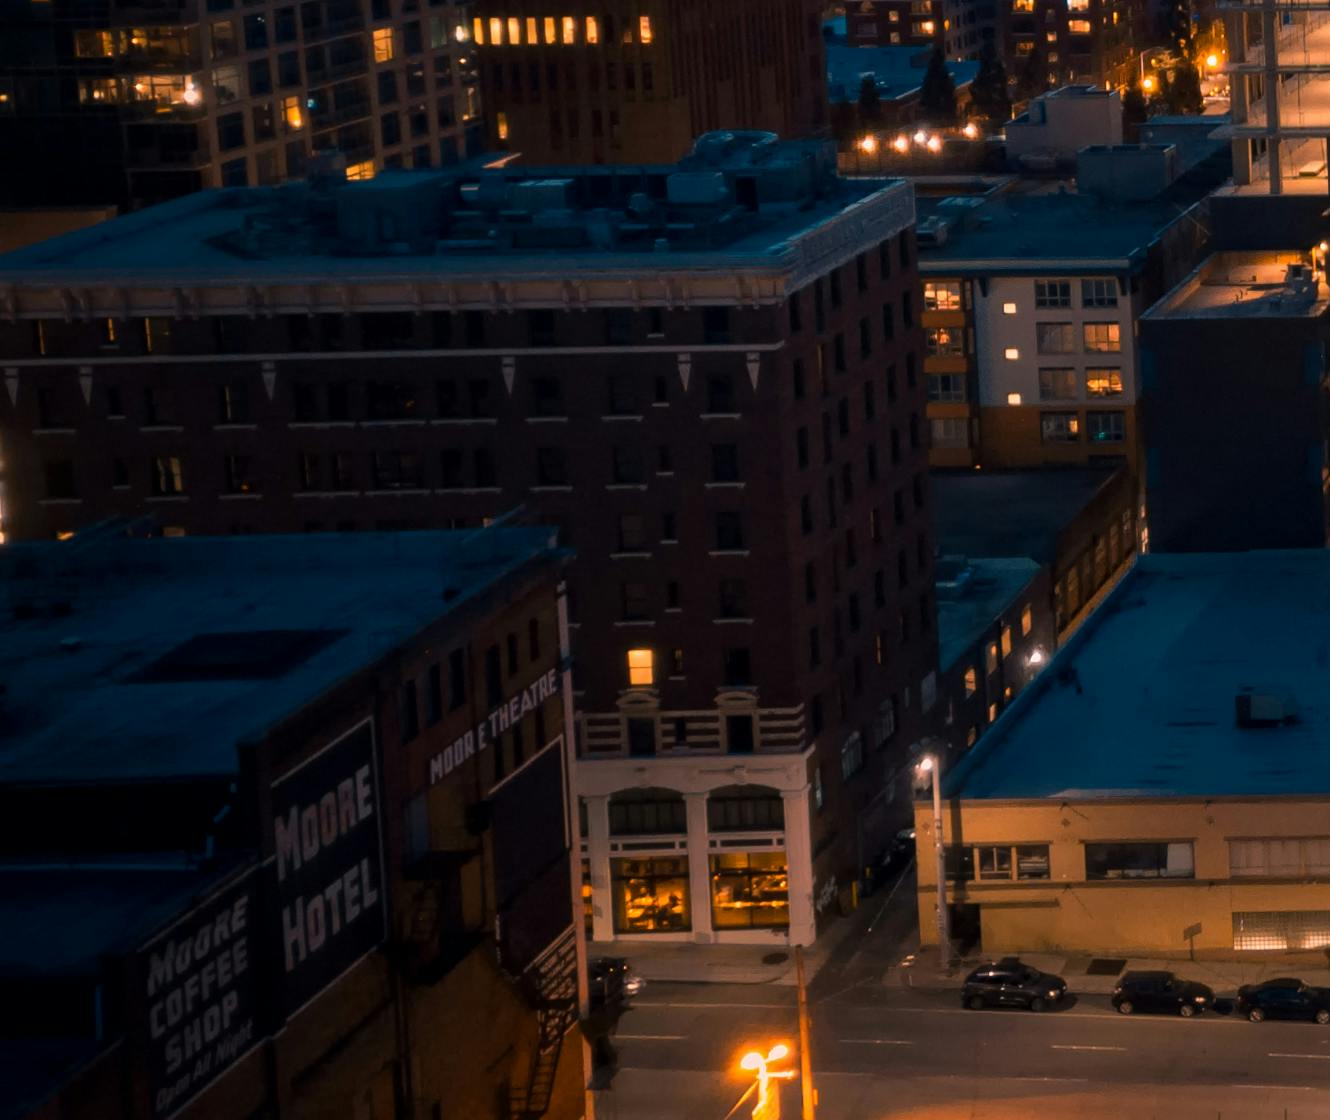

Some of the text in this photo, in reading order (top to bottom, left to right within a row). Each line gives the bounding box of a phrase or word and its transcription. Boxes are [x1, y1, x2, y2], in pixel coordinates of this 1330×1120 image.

[430, 668, 558, 785] MOORE THEATRE
[274, 764, 373, 881] MOORE
[147, 895, 249, 997] MOORE
[282, 857, 378, 972] HOTEL
[150, 935, 249, 1040] COFFEE
[166, 989, 238, 1075] SHOP
